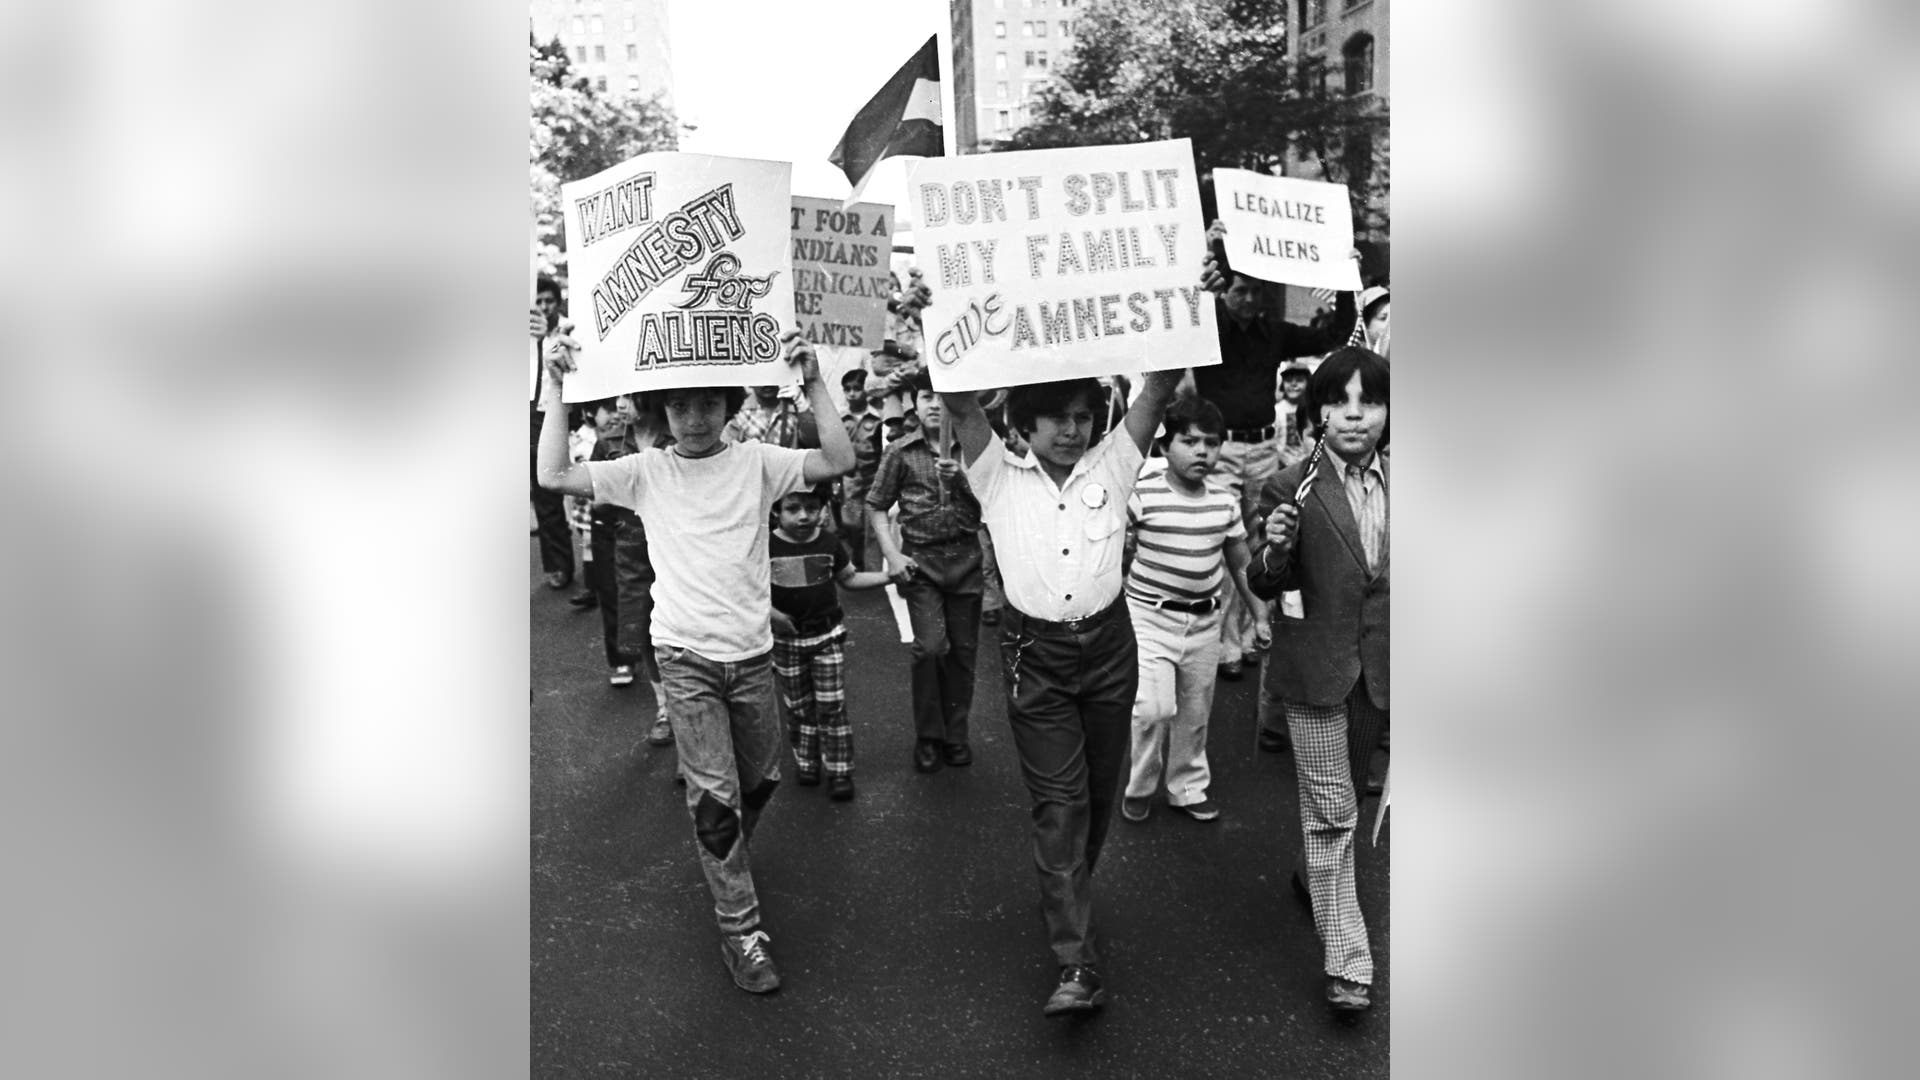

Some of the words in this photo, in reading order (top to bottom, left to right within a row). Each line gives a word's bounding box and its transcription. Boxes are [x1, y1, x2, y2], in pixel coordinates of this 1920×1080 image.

[575, 171, 656, 247] WANT
[815, 209, 862, 235] FOR
[871, 214, 887, 237] A
[920, 176, 1042, 227] DON'T
[1063, 169, 1179, 216] SPLIT
[1234, 192, 1325, 224] LEGALIZE
[592, 183, 745, 342] AMNESTY
[791, 236, 878, 267] NDIANS
[937, 238, 998, 289] MY
[1025, 223, 1179, 279] FAMILY
[1253, 235, 1320, 262] ALIENS
[669, 251, 780, 310] for
[792, 268, 889, 299] ERICANS
[635, 311, 780, 371] ALIENS
[796, 321, 863, 347] ANTS
[934, 293, 1012, 367] GIVE
[1010, 285, 1202, 351] AMNESTY
